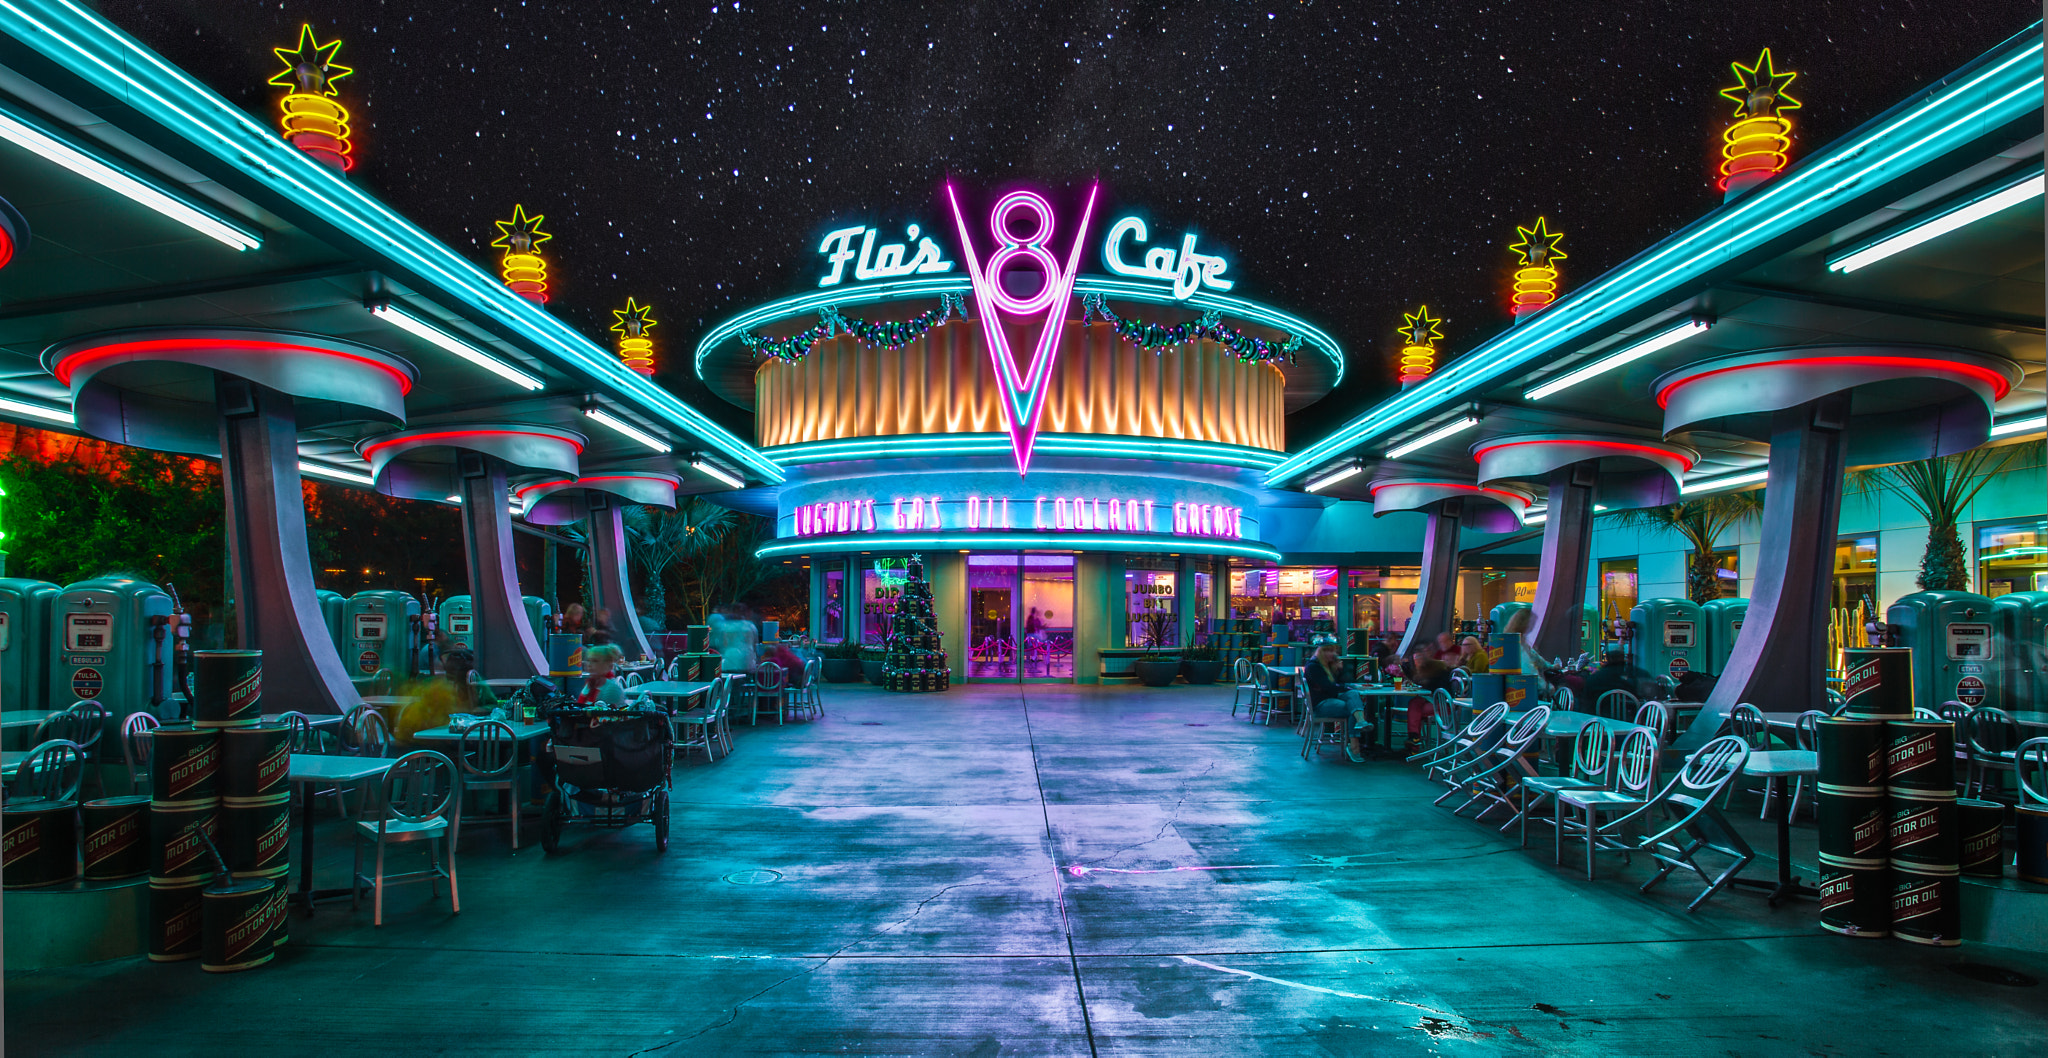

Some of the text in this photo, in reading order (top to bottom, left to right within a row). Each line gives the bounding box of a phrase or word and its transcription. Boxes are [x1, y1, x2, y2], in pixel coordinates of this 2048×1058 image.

[819, 224, 955, 287] Flo's
[1103, 216, 1235, 300] Cafe
[794, 496, 1243, 539] LUGNUTS GAS OIL COOLANT GREASE
[875, 587, 900, 599] DIP
[1132, 584, 1173, 595] JUMBO
[72, 656, 103, 664] REGULAR
[1862, 665, 1879, 679] OIL
[1894, 735, 1908, 746] BIG
[1917, 740, 1935, 754] OIL
[171, 755, 209, 784] MOTOR
[1896, 809, 1910, 819] BIG
[1919, 814, 1936, 828] OIL
[18, 826, 38, 844] OIL
[87, 818, 138, 853] OTOR OIL
[1854, 820, 1881, 841] MOTO
[166, 835, 202, 860] MOTO
[1836, 881, 1852, 893] OIL
[1898, 882, 1912, 892] BIG
[1890, 889, 1939, 911] OTOR OIL
[227, 913, 265, 947] MOTOR
